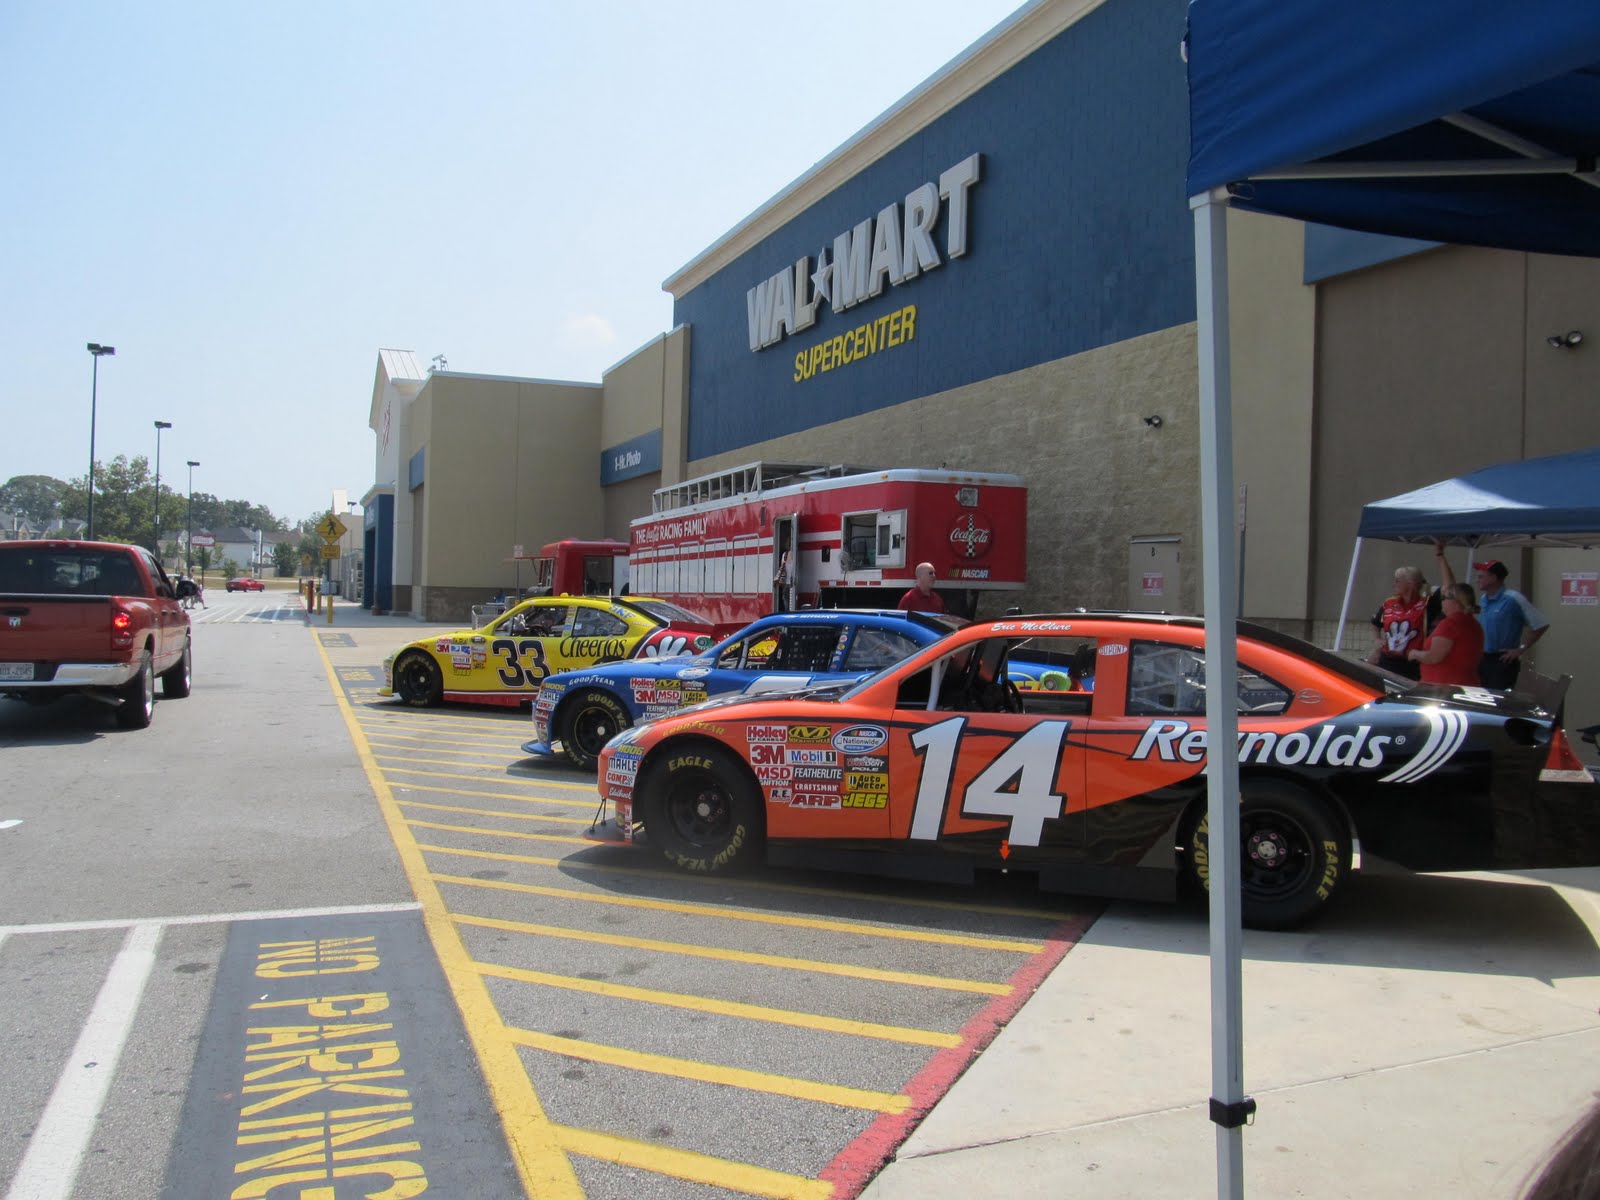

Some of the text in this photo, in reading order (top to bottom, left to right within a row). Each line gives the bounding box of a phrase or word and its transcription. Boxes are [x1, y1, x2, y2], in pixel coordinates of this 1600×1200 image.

[793, 304, 917, 382] SUPERCENTER
[626, 450, 641, 467] Photo
[636, 529, 646, 544] THE
[660, 523, 683, 540] RACING
[684, 518, 708, 537] FAMILY
[961, 569, 989, 579] NASCAR
[991, 621, 1072, 631] Eric McClure
[437, 644, 449, 653] 3M
[560, 635, 628, 659] Cheerios
[492, 639, 551, 687] 33
[568, 675, 615, 686] GOODYEAR
[632, 679, 654, 688] Holley
[636, 690, 655, 703] 3M
[658, 691, 680, 699] MSD
[663, 720, 725, 736] GOODYEAR
[748, 727, 786, 741] Holley
[843, 737, 880, 745] Nationwide
[618, 745, 644, 755] MOOG
[1132, 720, 1392, 775] Renolds
[752, 745, 785, 764] 3M
[791, 751, 823, 762] Mobil
[609, 757, 637, 771] MAHLE
[668, 756, 713, 771] EAGLE
[607, 772, 628, 783] COMP
[757, 767, 790, 779] MSD
[794, 768, 842, 779] FEATHERLITE
[859, 775, 881, 783] Auto
[795, 783, 838, 791] CRAFTSMAN
[857, 782, 886, 790] Meter
[911, 716, 1068, 847] 14
[791, 795, 840, 806] ARP
[842, 793, 888, 808] JEGS
[1316, 841, 1339, 900] EAGLE
[255, 936, 381, 978] NO
